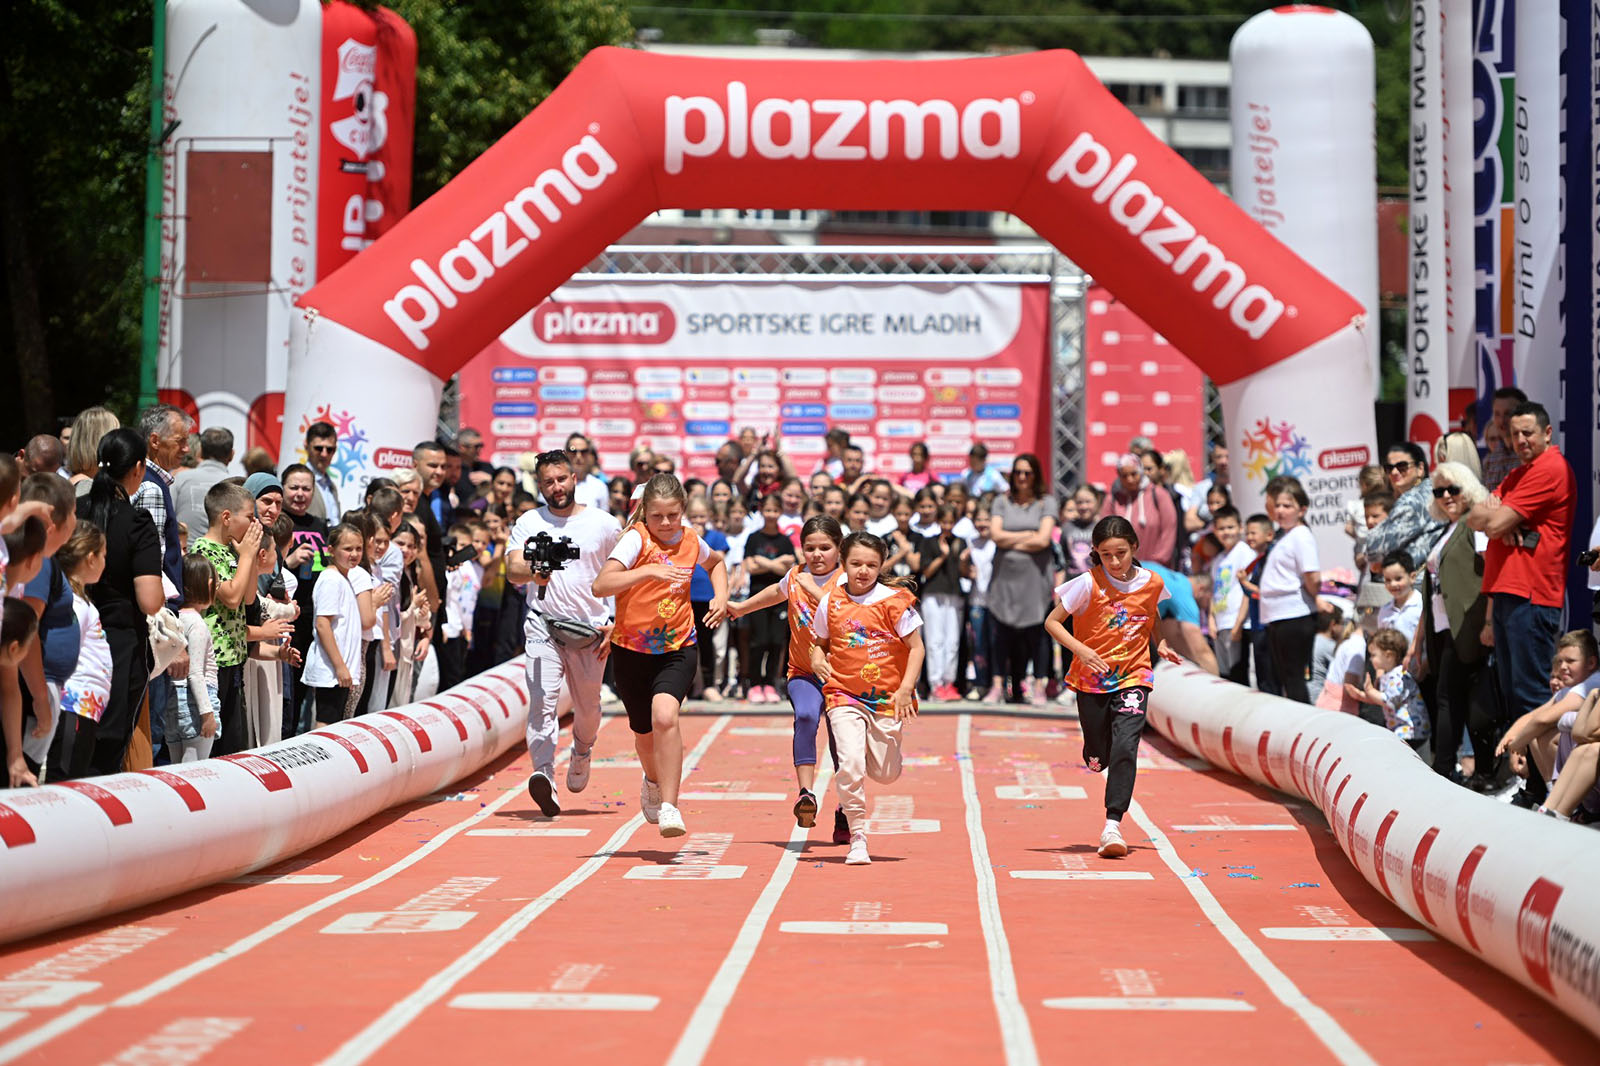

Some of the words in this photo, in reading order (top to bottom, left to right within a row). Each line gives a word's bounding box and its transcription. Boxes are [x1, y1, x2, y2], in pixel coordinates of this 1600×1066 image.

[1413, 0, 1427, 107] MLAD
[664, 81, 1021, 175] plazma
[1249, 102, 1285, 228] ijatelje!
[1413, 123, 1429, 203] IGRE
[1515, 95, 1531, 184] sebi
[383, 134, 618, 350] plazma
[1046, 131, 1286, 340] plazma
[543, 306, 661, 341] plazma
[686, 312, 811, 335] SPORTSKE
[819, 313, 876, 334] IGRE
[883, 313, 982, 334] MLADIH
[1411, 214, 1431, 400] SPORTSKE
[1517, 239, 1537, 340] brini
[379, 450, 414, 467] plazm
[1309, 476, 1360, 493] SPORT
